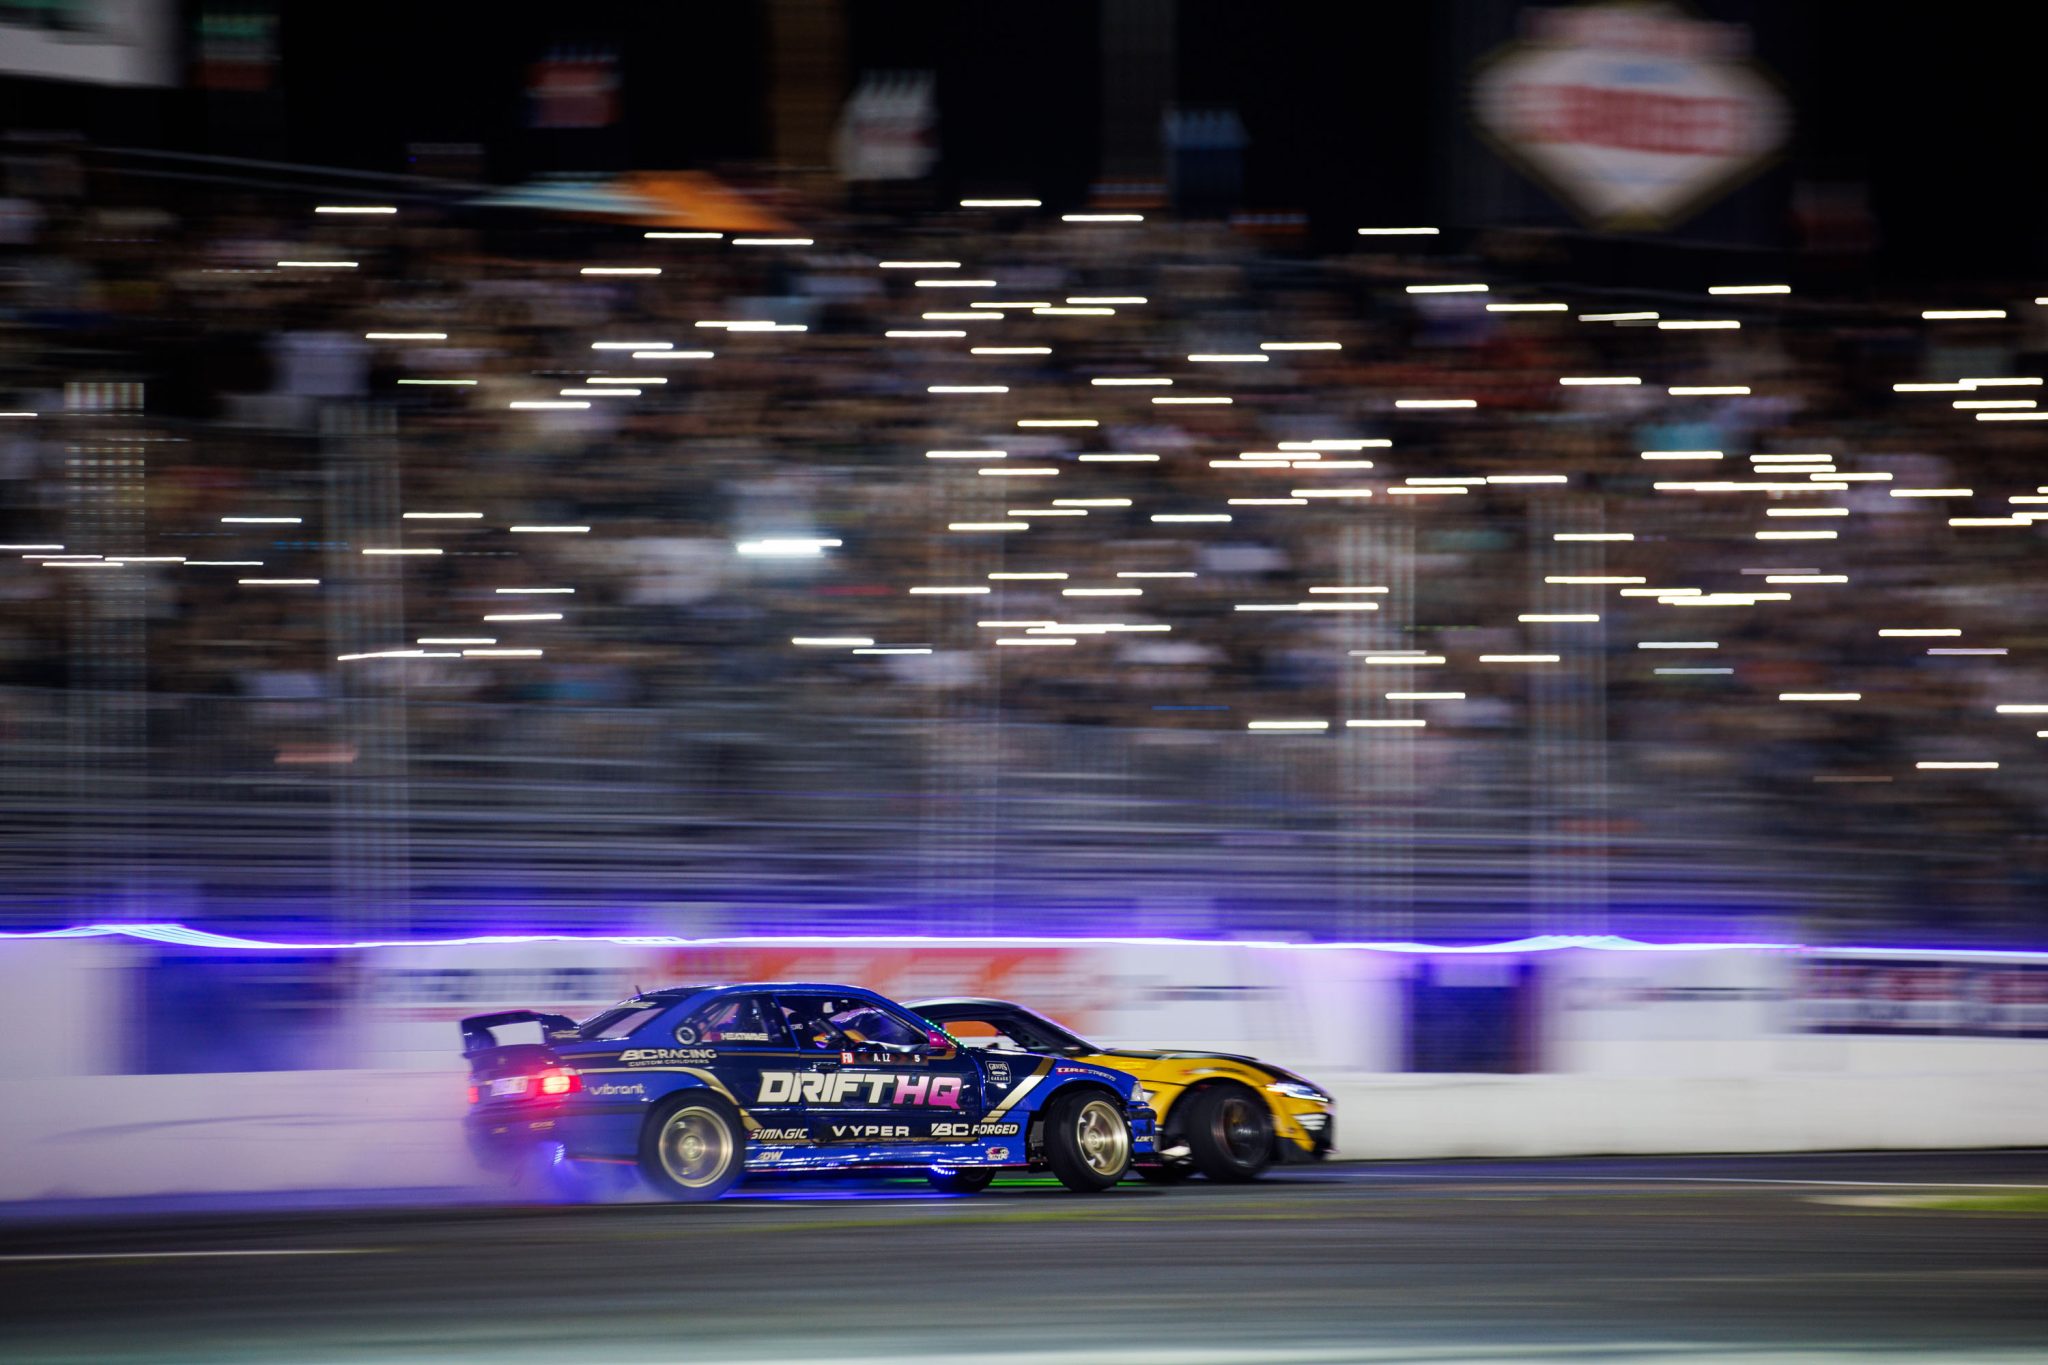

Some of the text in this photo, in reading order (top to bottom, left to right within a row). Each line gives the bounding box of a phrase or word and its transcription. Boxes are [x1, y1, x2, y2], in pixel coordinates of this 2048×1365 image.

[914, 1054, 921, 1063] 5
[589, 1083, 645, 1096] vibrant
[757, 1071, 962, 1110] DRIFTHQ
[750, 1127, 809, 1140] SIMAGIC
[831, 1125, 910, 1137] VYPER
[971, 1124, 1019, 1135] FORGED
